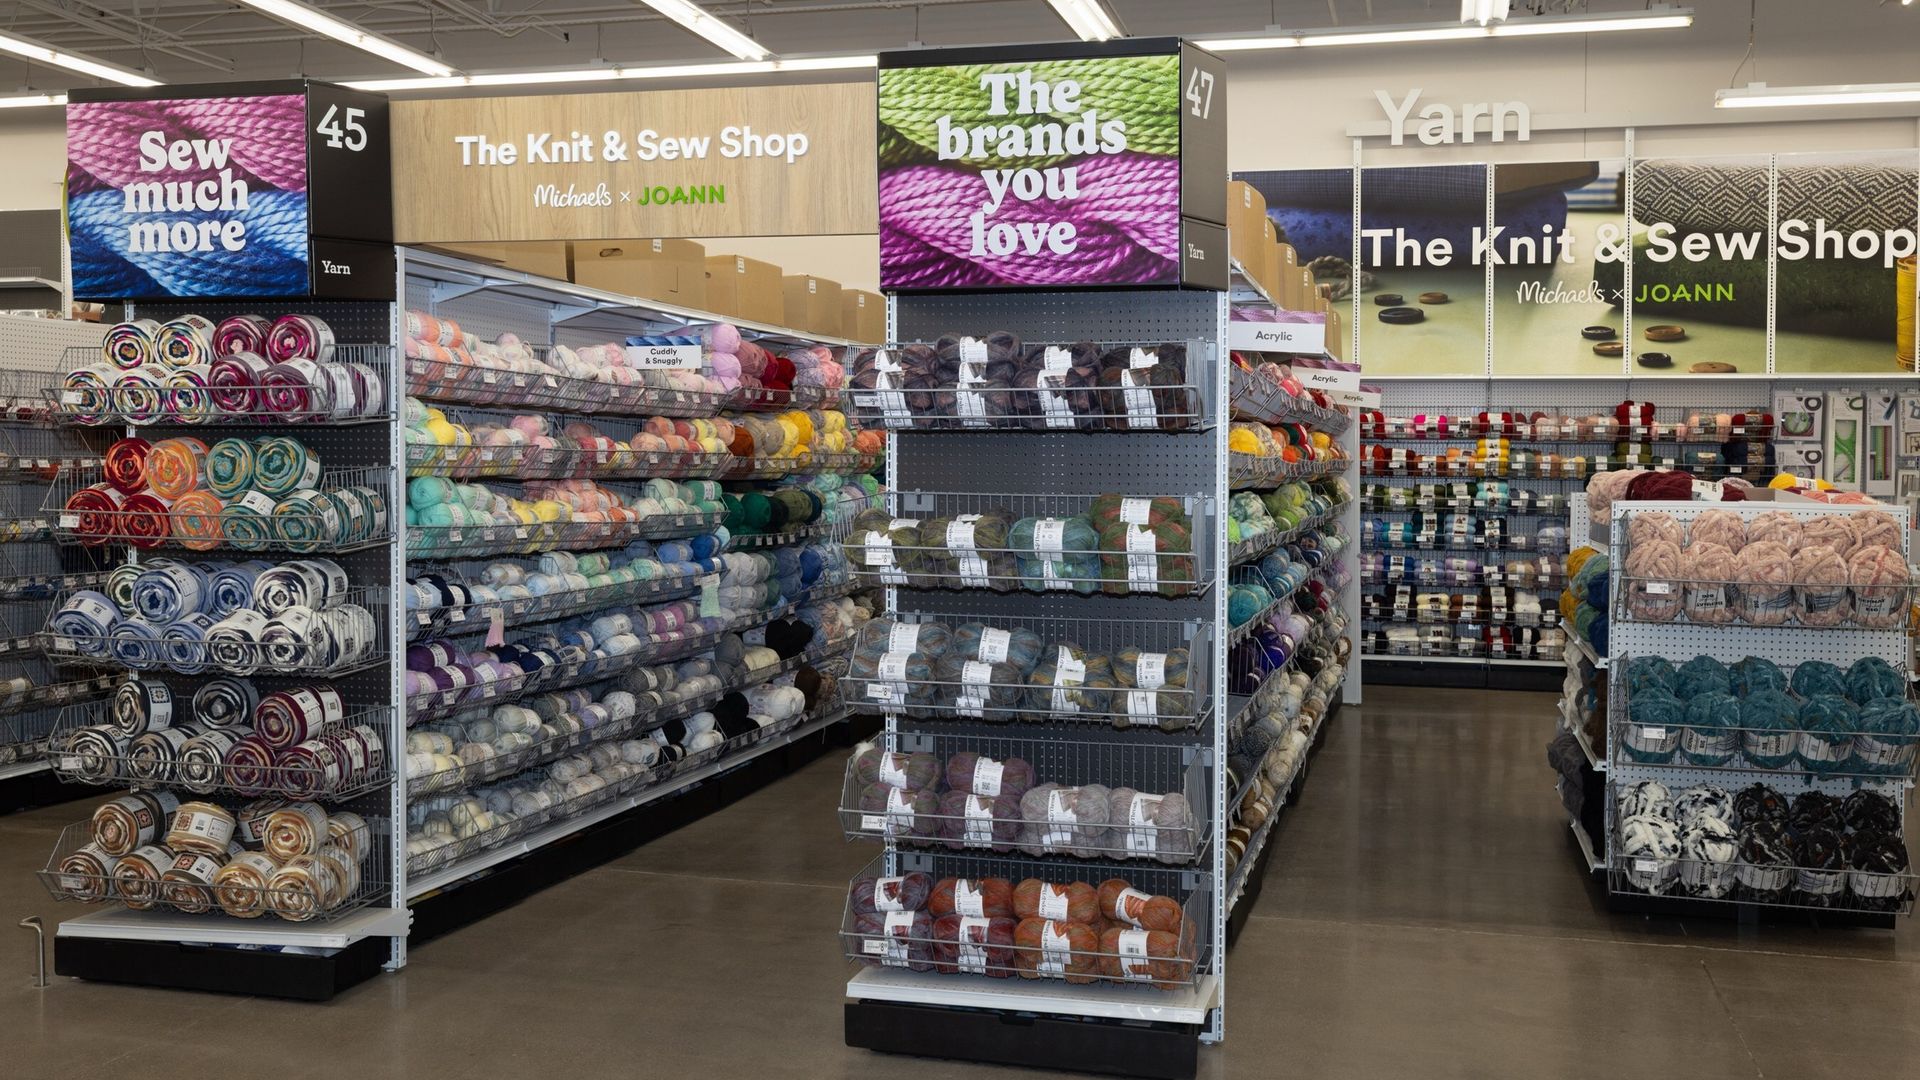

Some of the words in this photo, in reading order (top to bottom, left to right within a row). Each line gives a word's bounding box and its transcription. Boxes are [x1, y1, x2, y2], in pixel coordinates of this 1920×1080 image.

[980, 69, 1081, 116] The
[1186, 66, 1214, 120] 47
[316, 104, 367, 152] 45
[936, 109, 1127, 161] brands
[1373, 88, 1531, 146] Yarn
[139, 130, 233, 172] Sew
[455, 134, 518, 166] The
[526, 130, 594, 163] Knit
[603, 130, 628, 162] &
[636, 129, 710, 161] Sew
[719, 125, 808, 164] Shop
[123, 168, 250, 213] much
[533, 182, 612, 208] Michaels
[638, 184, 726, 207] JOANN
[981, 166, 1081, 215] you
[128, 219, 247, 253] more
[969, 212, 1077, 257] love
[1188, 243, 1205, 261] Yarn
[1361, 227, 1453, 267] The
[1471, 223, 1577, 266] Knit
[1593, 223, 1628, 264] &
[1646, 221, 1762, 263] Sew
[1777, 217, 1917, 268] Shop
[321, 260, 351, 276] Yarn
[1516, 280, 1605, 306] Michaels
[1635, 282, 1736, 303] JOANN
[650, 347, 678, 359] Cuddly
[1255, 330, 1293, 343] Acrylic
[645, 357, 651, 365] &
[652, 356, 683, 367] Snuggly
[1312, 374, 1338, 384] Acrylic
[1343, 394, 1363, 403] Acrylic
